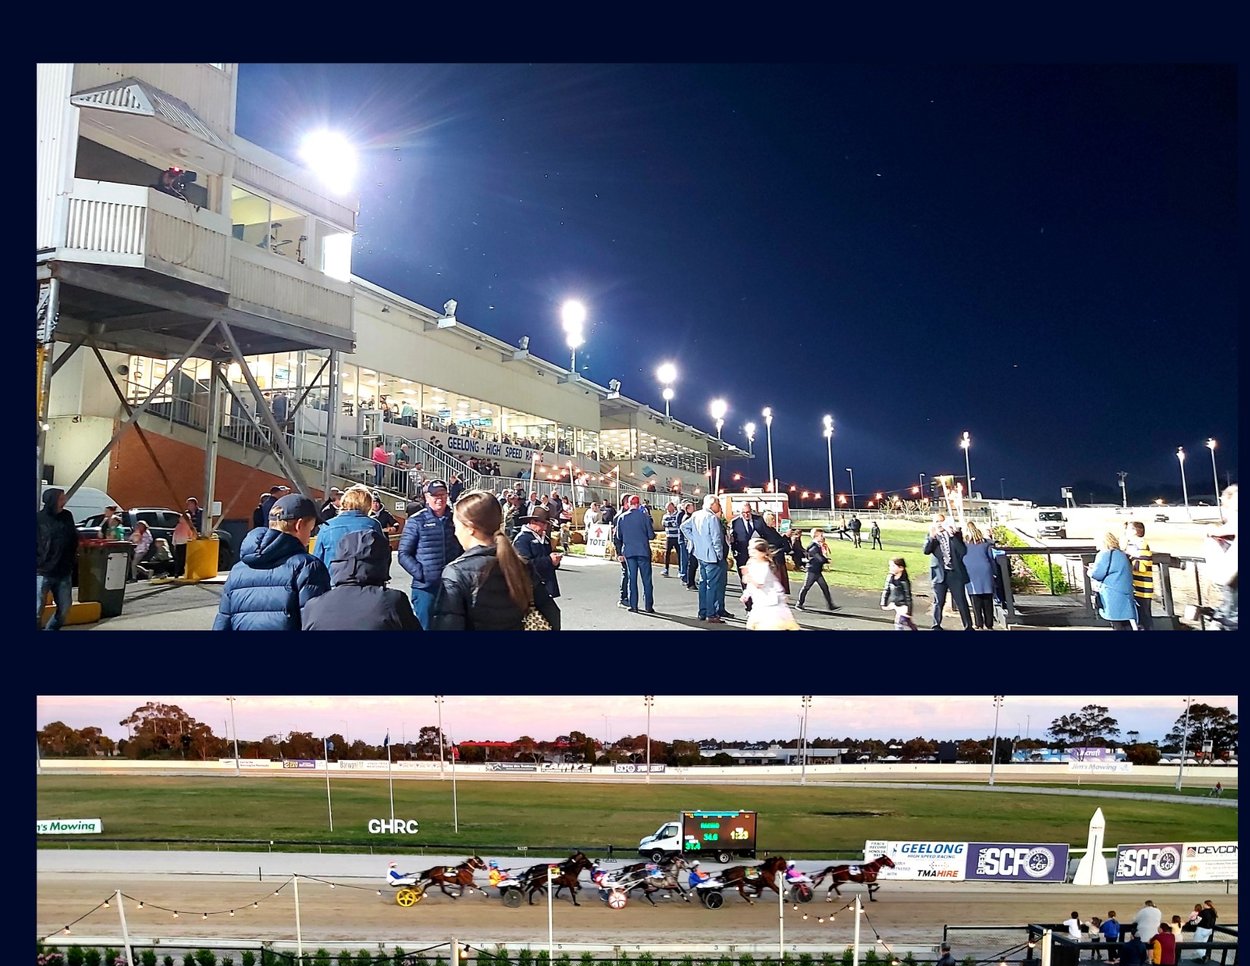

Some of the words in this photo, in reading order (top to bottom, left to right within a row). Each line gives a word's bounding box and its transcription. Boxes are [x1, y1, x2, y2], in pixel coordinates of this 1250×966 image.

[447, 436, 480, 453] GEELONG
[486, 443, 501, 456] HIGH
[505, 447, 522, 459] SPEED
[526, 451, 544, 463] RAG
[589, 538, 606, 547] TOTE
[1088, 762, 1117, 772] Mowing
[49, 820, 95, 831] Mowing
[368, 818, 419, 834] GHRC
[901, 843, 964, 854] GEELONG
[985, 847, 1030, 876] SCF
[1123, 848, 1161, 877] SCF
